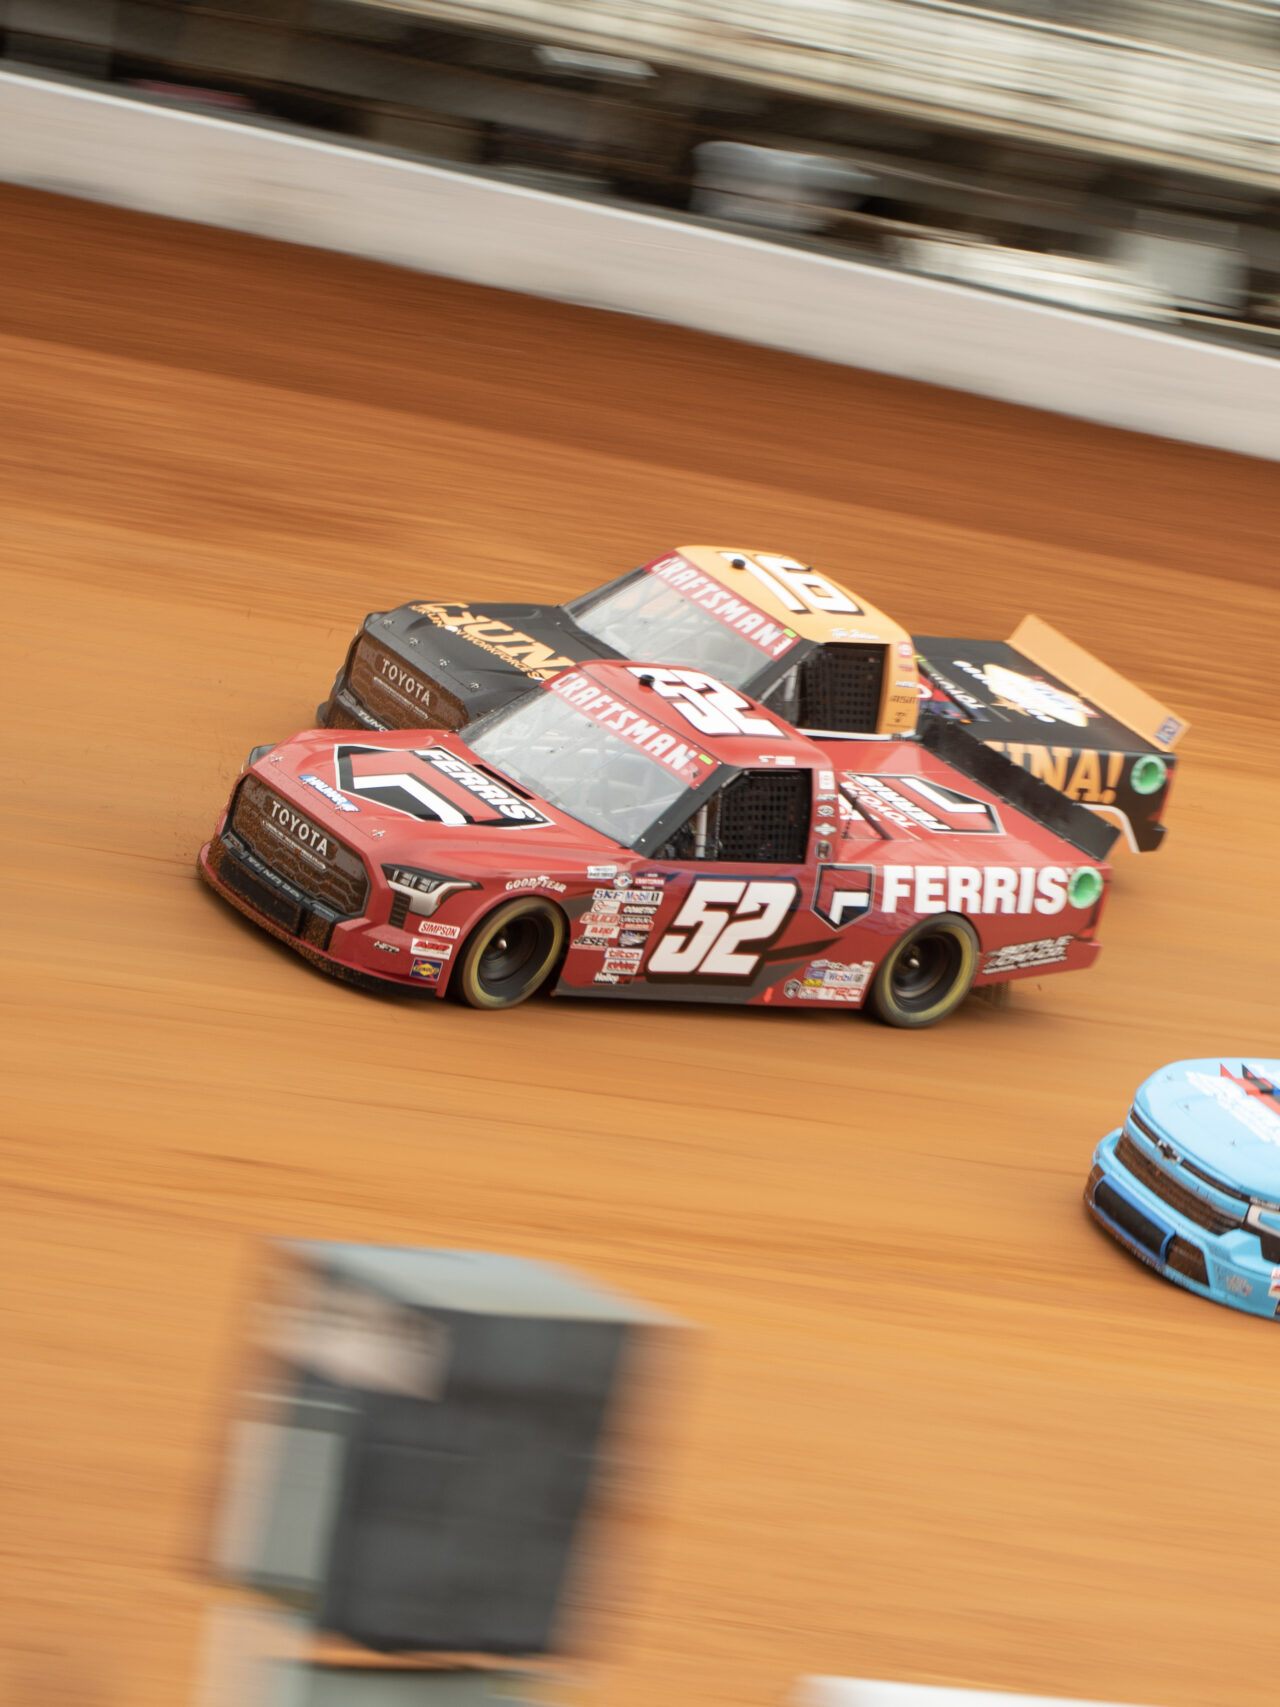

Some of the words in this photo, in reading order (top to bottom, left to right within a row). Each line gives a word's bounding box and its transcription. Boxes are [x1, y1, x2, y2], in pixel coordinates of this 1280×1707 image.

[652, 556, 781, 648] CRAFTSMAN
[719, 551, 864, 616] 16
[413, 602, 576, 680] LIUN
[381, 659, 431, 707] TOYOTA
[624, 667, 788, 738] 52
[550, 672, 698, 771] CRAFTSMAN
[414, 749, 536, 820] FERRIS
[271, 800, 329, 857] TOYOTA
[505, 875, 567, 893] GOODYEAR
[594, 890, 624, 900] SKF
[881, 865, 1069, 915] FERRIS
[421, 922, 457, 937] SIMPSON
[648, 880, 798, 976] 52
